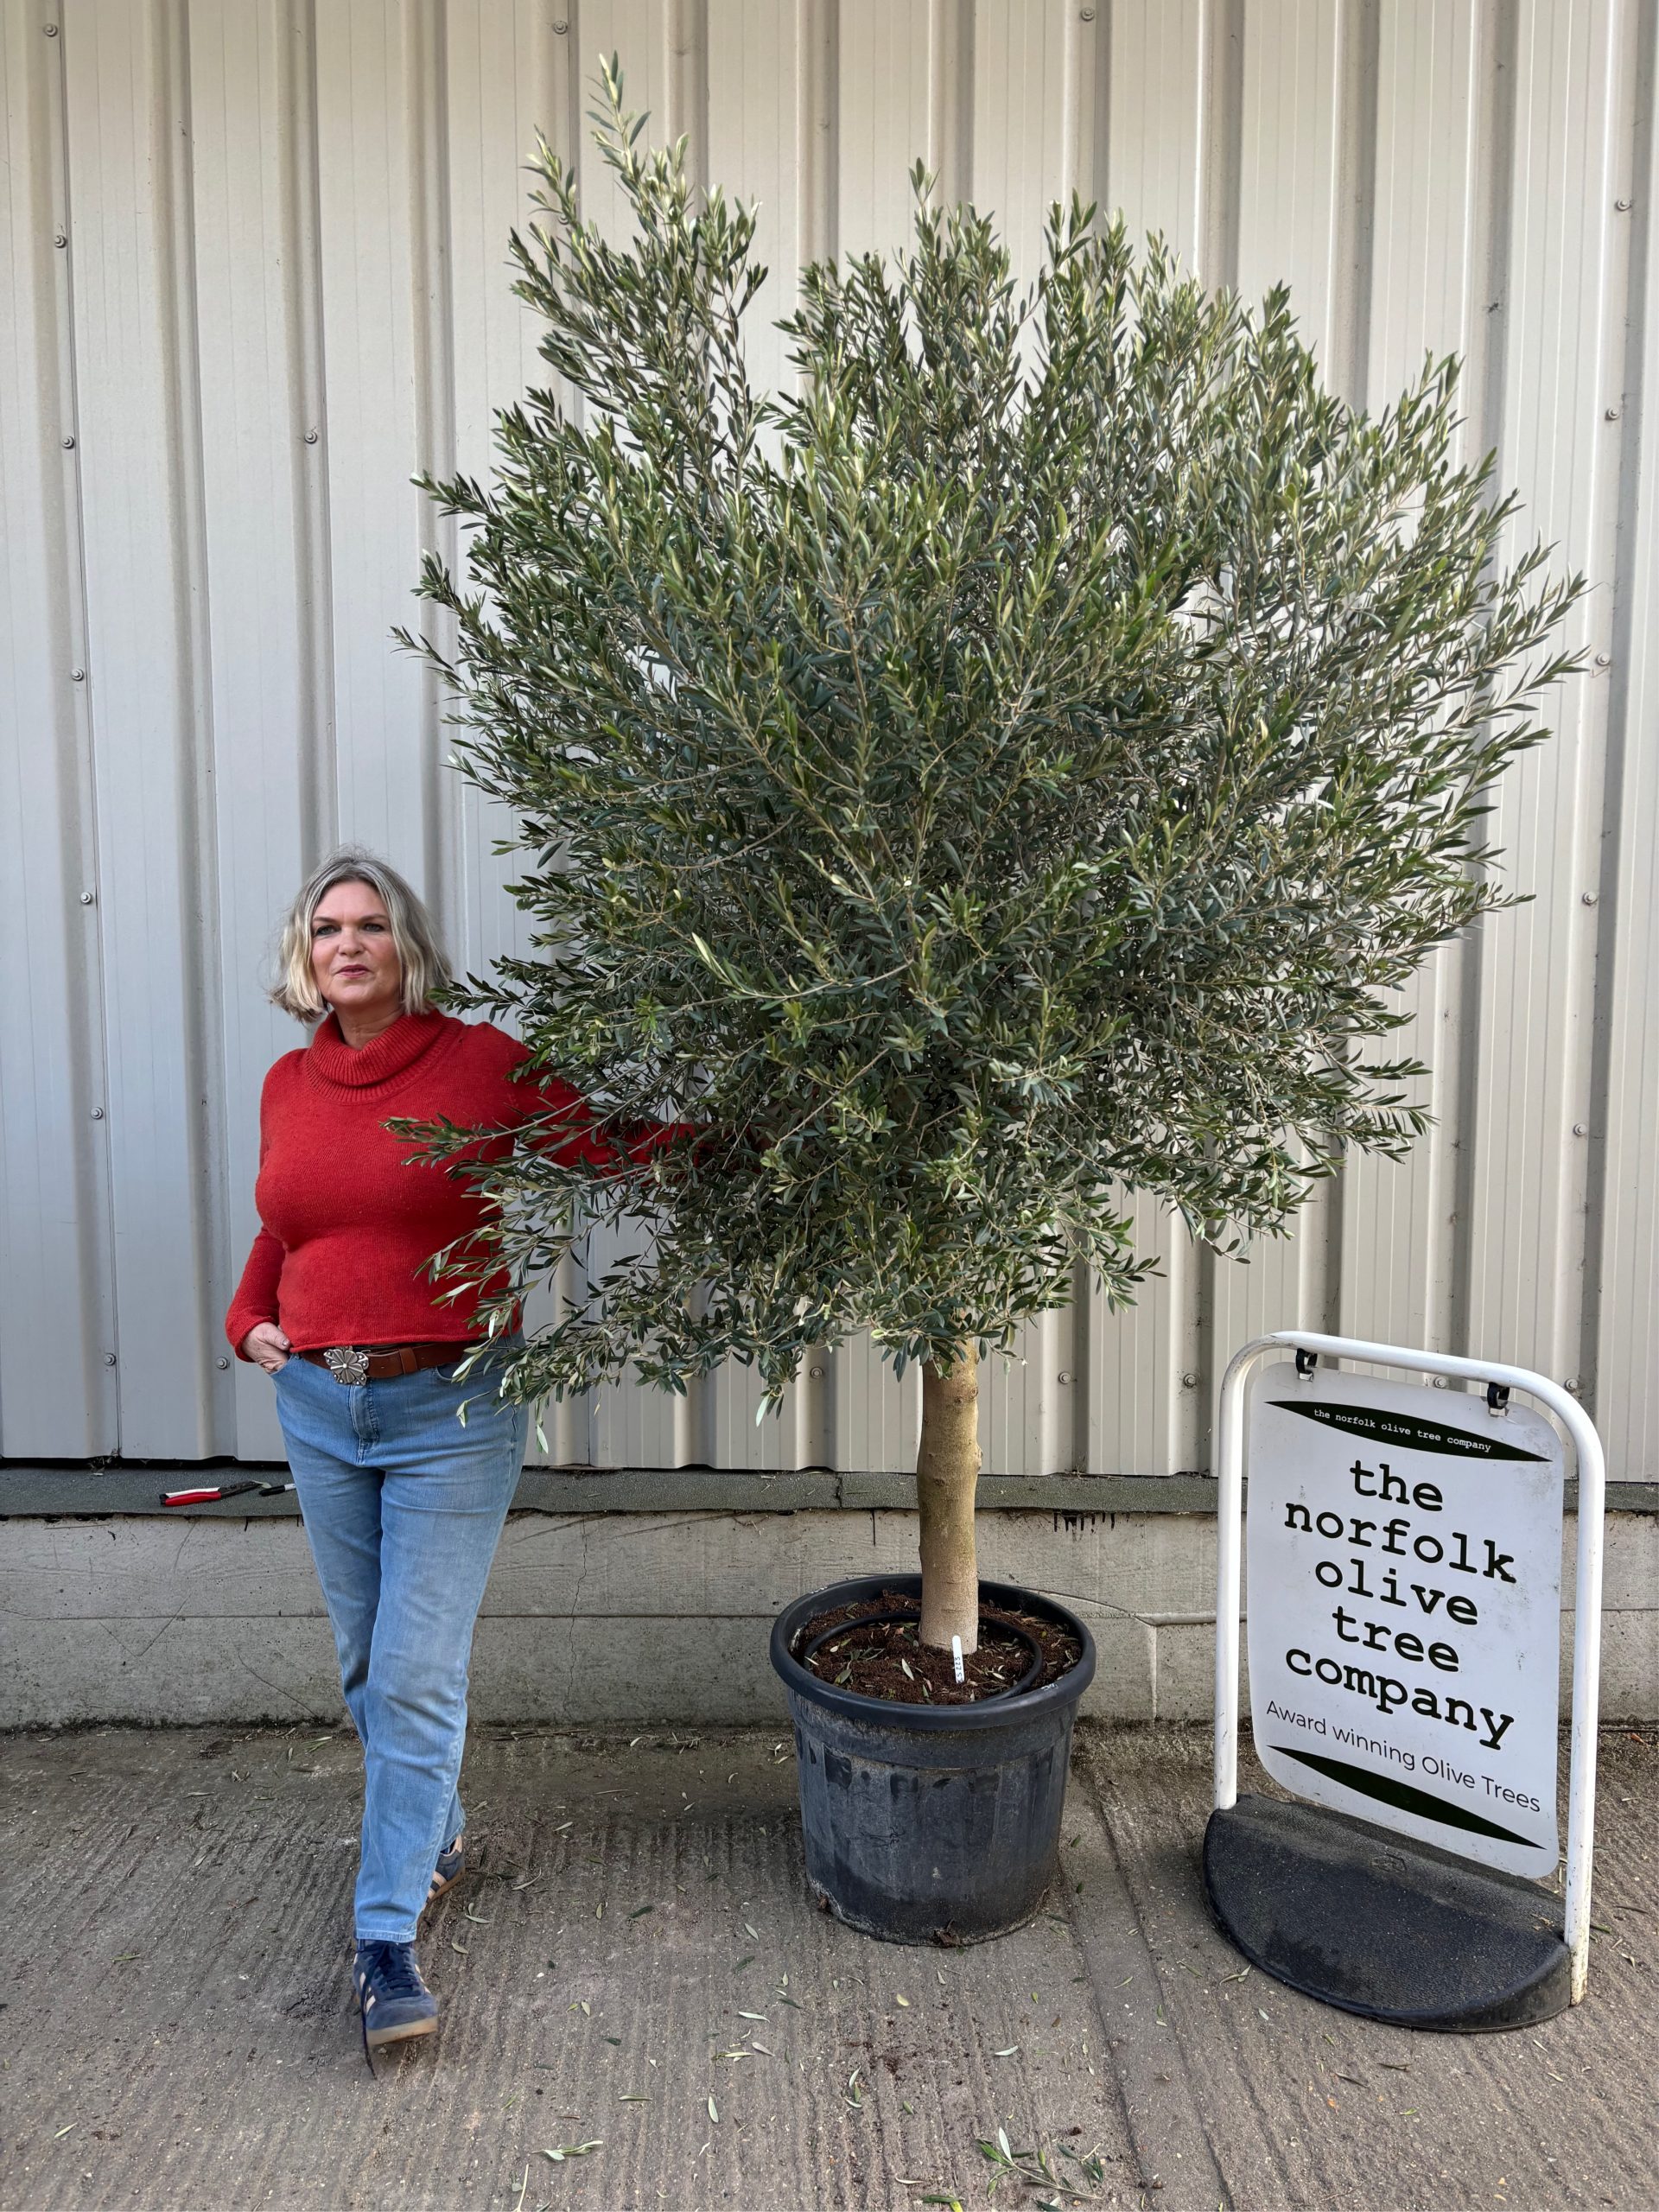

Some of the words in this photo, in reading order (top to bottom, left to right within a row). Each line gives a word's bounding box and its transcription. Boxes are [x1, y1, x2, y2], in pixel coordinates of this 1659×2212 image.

[1314, 1409, 1331, 1419] the
[1335, 1414, 1376, 1428] norfolk
[1381, 1422, 1411, 1435] olive
[1417, 1429, 1441, 1441] tree
[1446, 1437, 1491, 1453] company
[1350, 1460, 1442, 1512] the
[1285, 1503, 1517, 1585] norfolk
[1315, 1560, 1478, 1626] olive
[1332, 1606, 1459, 1673] tree
[1286, 1649, 1515, 1751] company
[1267, 1700, 1326, 1736] Award
[1332, 1726, 1415, 1771] winning
[1421, 1757, 1476, 1789] Olive
[1480, 1776, 1541, 1813] Trees
